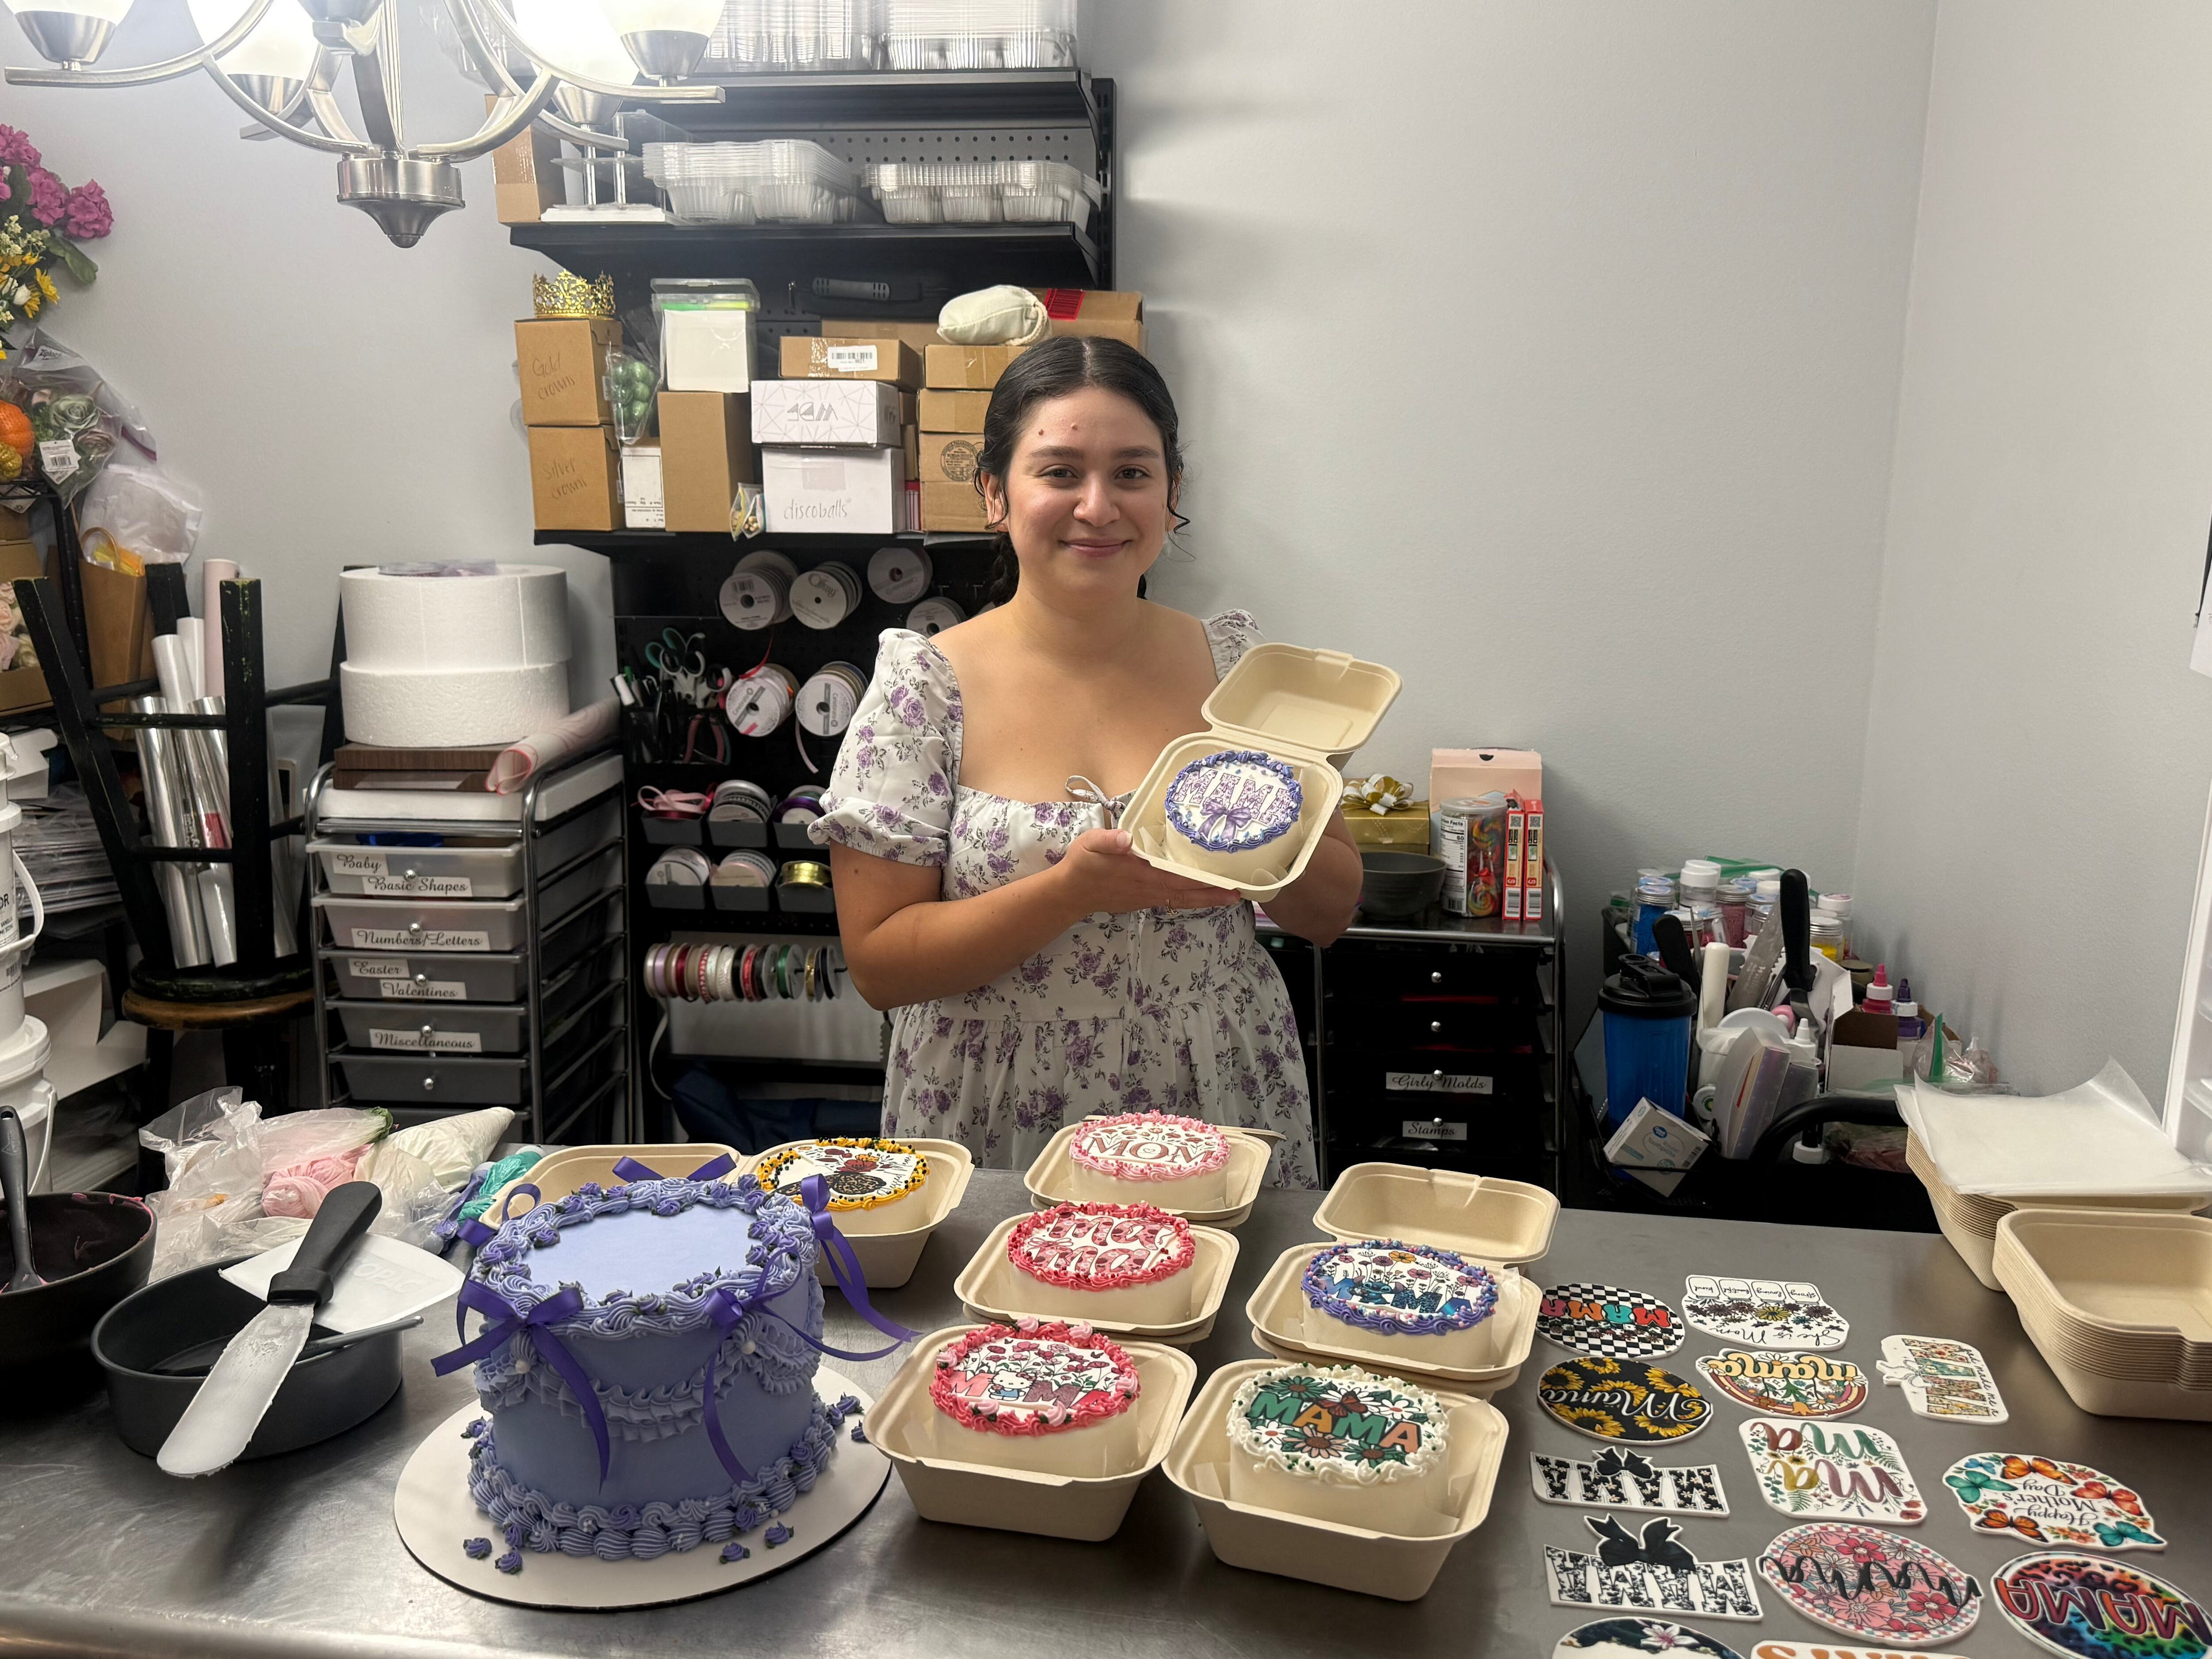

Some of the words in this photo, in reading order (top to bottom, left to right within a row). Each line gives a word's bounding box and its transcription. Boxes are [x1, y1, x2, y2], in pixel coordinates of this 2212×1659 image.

[533, 353, 561, 378] Gold
[538, 374, 575, 400] crowns
[543, 457, 575, 480] Silver
[784, 499, 847, 520] discoballs
[1172, 769, 1294, 826] MAMA
[336, 854, 382, 874] Baby
[368, 877, 413, 891] Basic
[418, 877, 468, 895] Shapes
[357, 929, 482, 947] Numbers/Letters
[354, 959, 402, 975] Easter
[383, 981, 458, 997] Valentines
[375, 1031, 475, 1049] Miscellaneous
[1392, 1074, 1435, 1091] Girly
[1442, 1076, 1486, 1089] Molds
[1408, 1121, 1456, 1139] Stamps
[1088, 1136, 1215, 1164] MOM
[1756, 1287, 1782, 1298] loving
[1790, 1290, 1816, 1298] strong
[1541, 1298, 1672, 1328] MAMA
[1709, 1327, 1767, 1344] Mom
[1797, 1330, 1840, 1346] She
[1707, 1352, 1858, 1381] mama
[1901, 1338, 1992, 1416] MAMA
[1974, 1365, 1992, 1391] made
[1987, 1392, 1999, 1406] me
[1543, 1388, 1711, 1422] Mama
[1246, 1392, 1423, 1453] MAMA
[1535, 1455, 1726, 1512] MAMA
[2013, 1479, 2065, 1497] Day
[2002, 1492, 2099, 1512] Mother's
[2013, 1504, 2098, 1526] Happy
[1546, 1546, 1759, 1616] MAMA
[1994, 1576, 2212, 1646] MAMA
